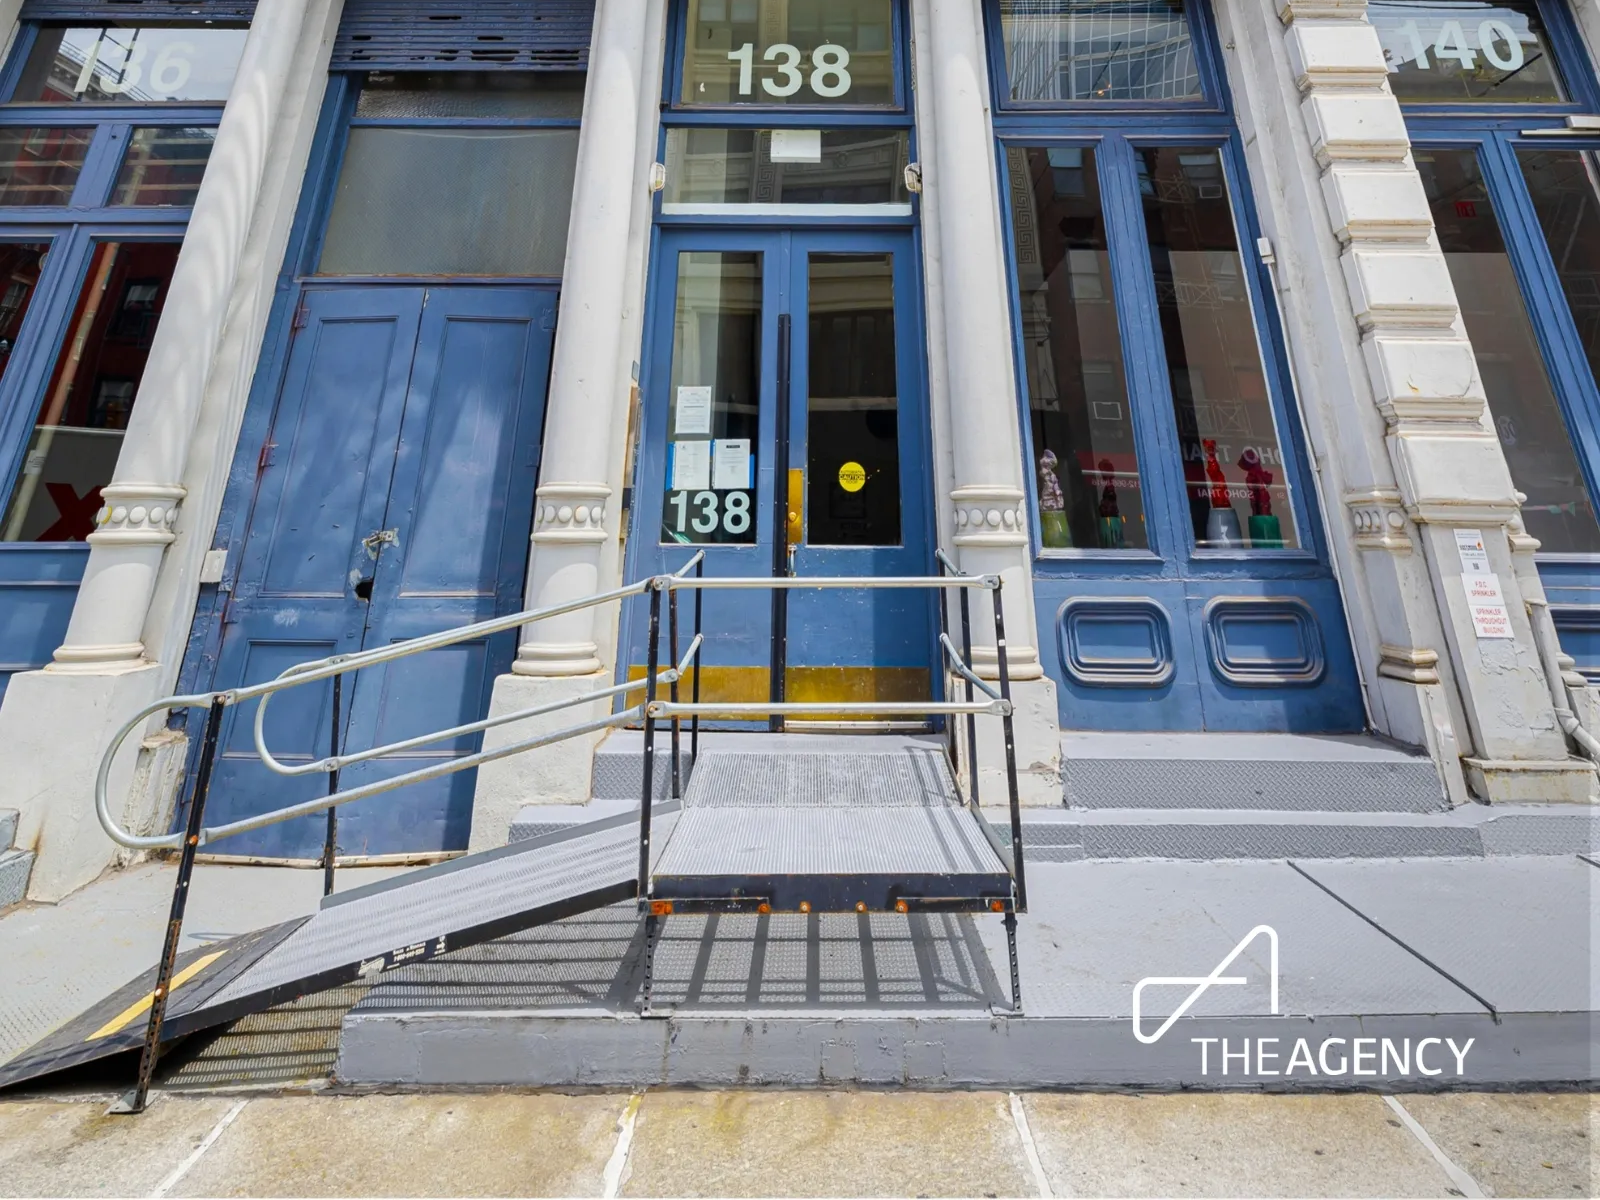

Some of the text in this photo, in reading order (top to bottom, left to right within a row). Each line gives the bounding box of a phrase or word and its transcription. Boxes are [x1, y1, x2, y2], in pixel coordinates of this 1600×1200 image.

[74, 40, 197, 94] 136
[727, 42, 852, 98] 138
[1394, 19, 1525, 72] 140
[669, 490, 751, 534] 138
